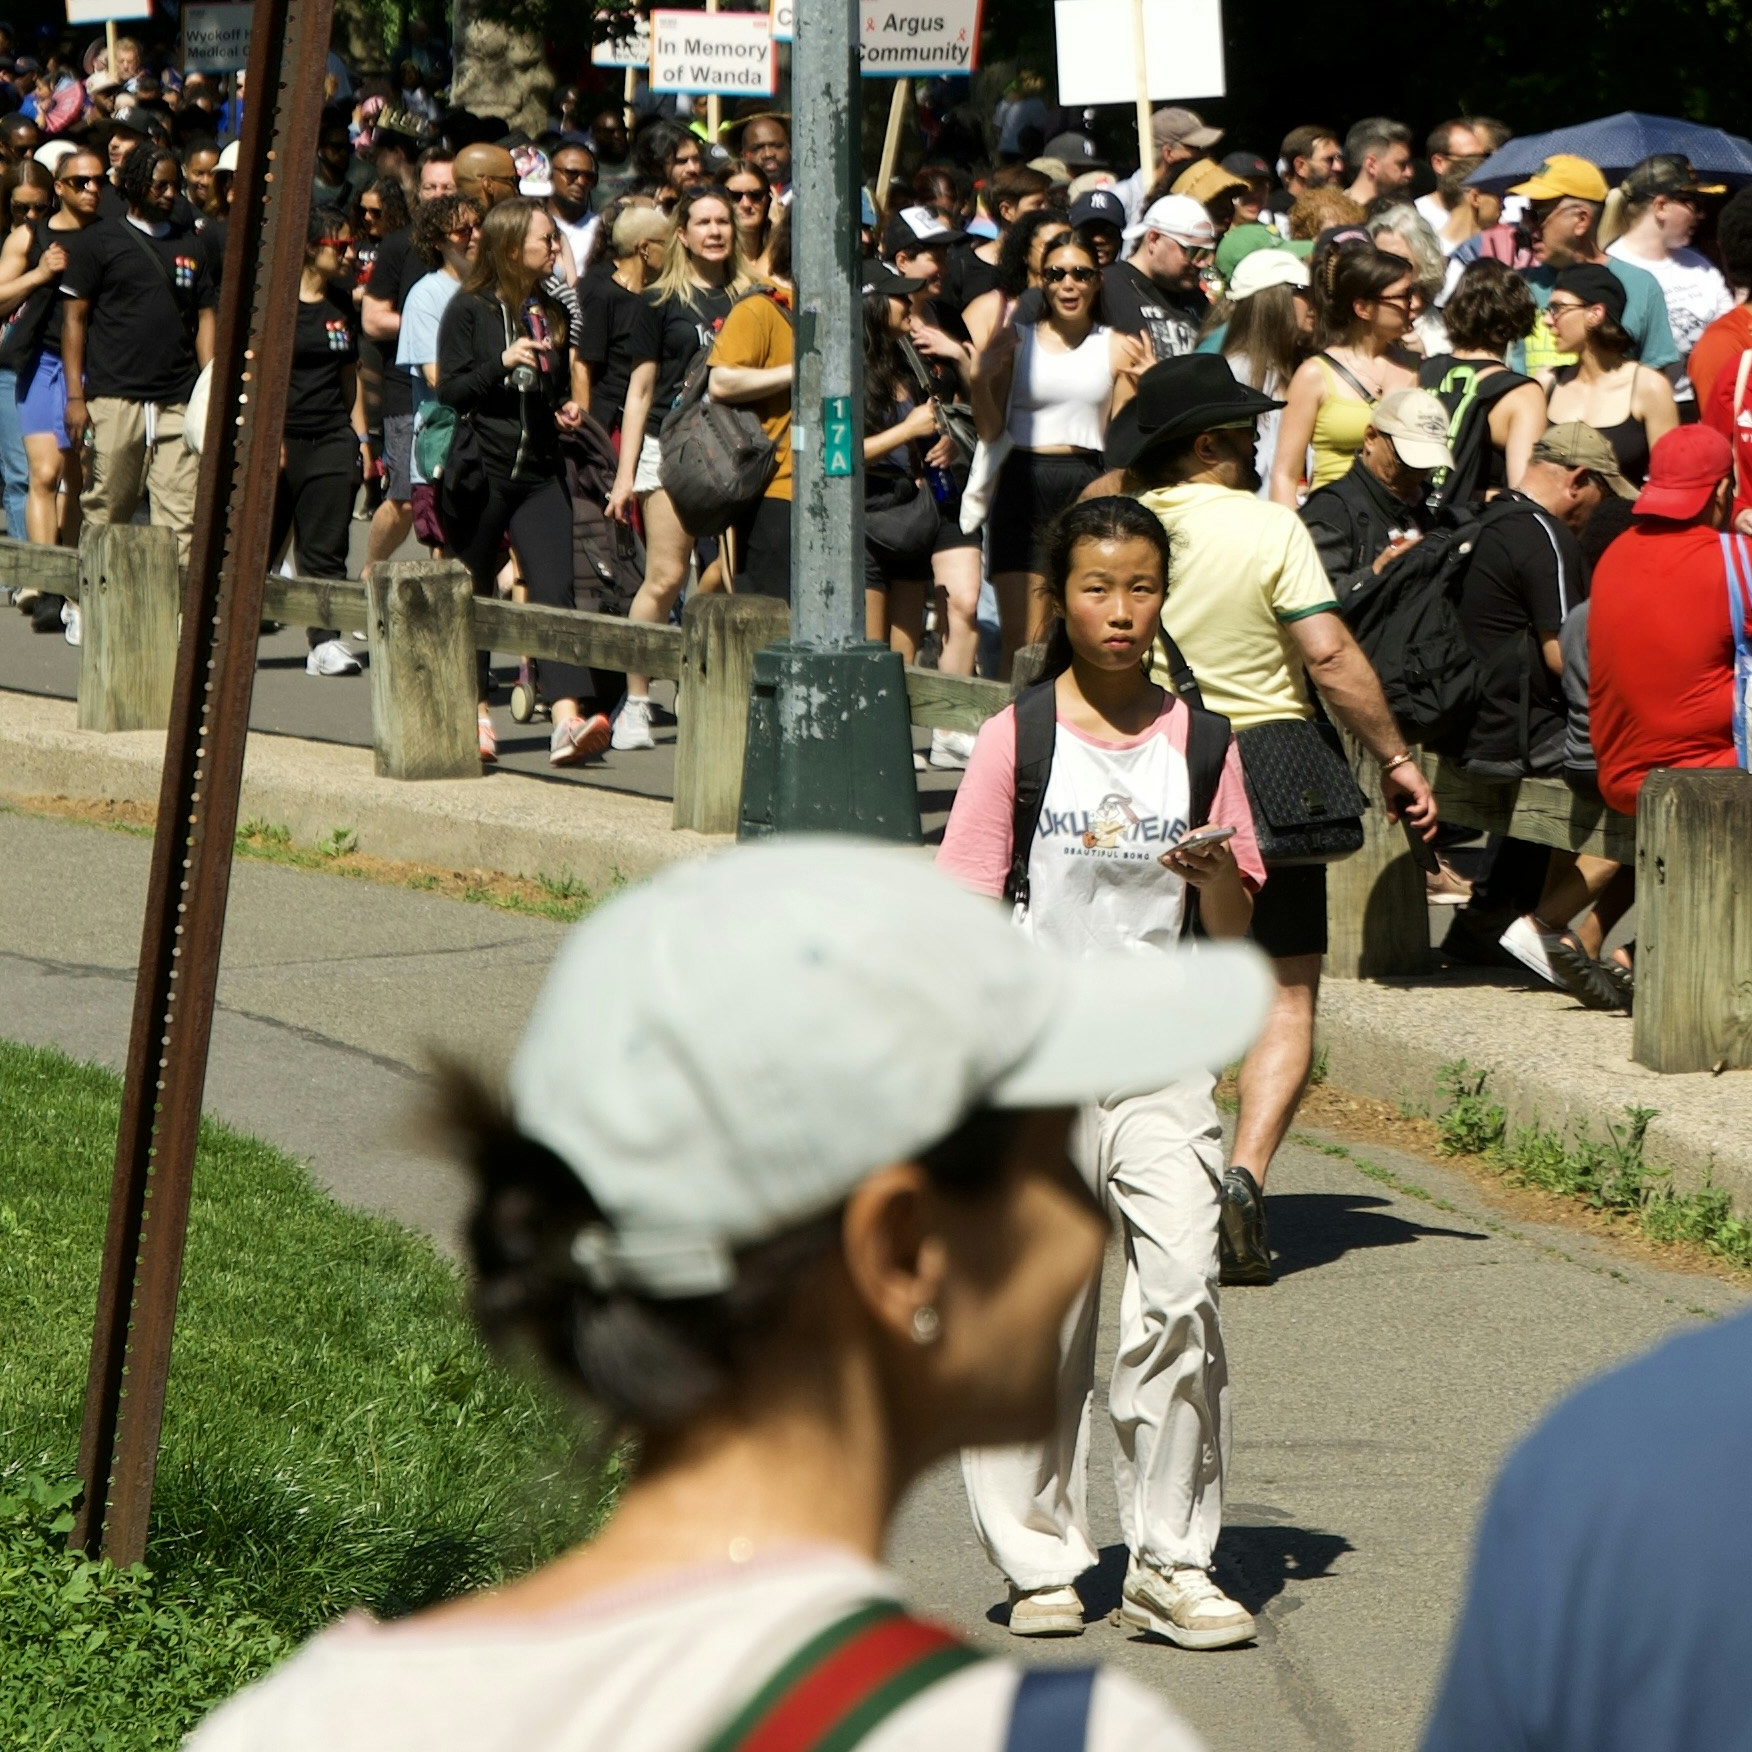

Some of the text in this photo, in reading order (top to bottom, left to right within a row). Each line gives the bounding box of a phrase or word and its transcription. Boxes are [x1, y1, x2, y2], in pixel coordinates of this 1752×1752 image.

[882, 13, 944, 36] Argus
[658, 38, 676, 55] In
[684, 39, 768, 62] Memory
[663, 65, 762, 85] of Wanda
[1063, 846, 1118, 859] BEAUTIFUL
